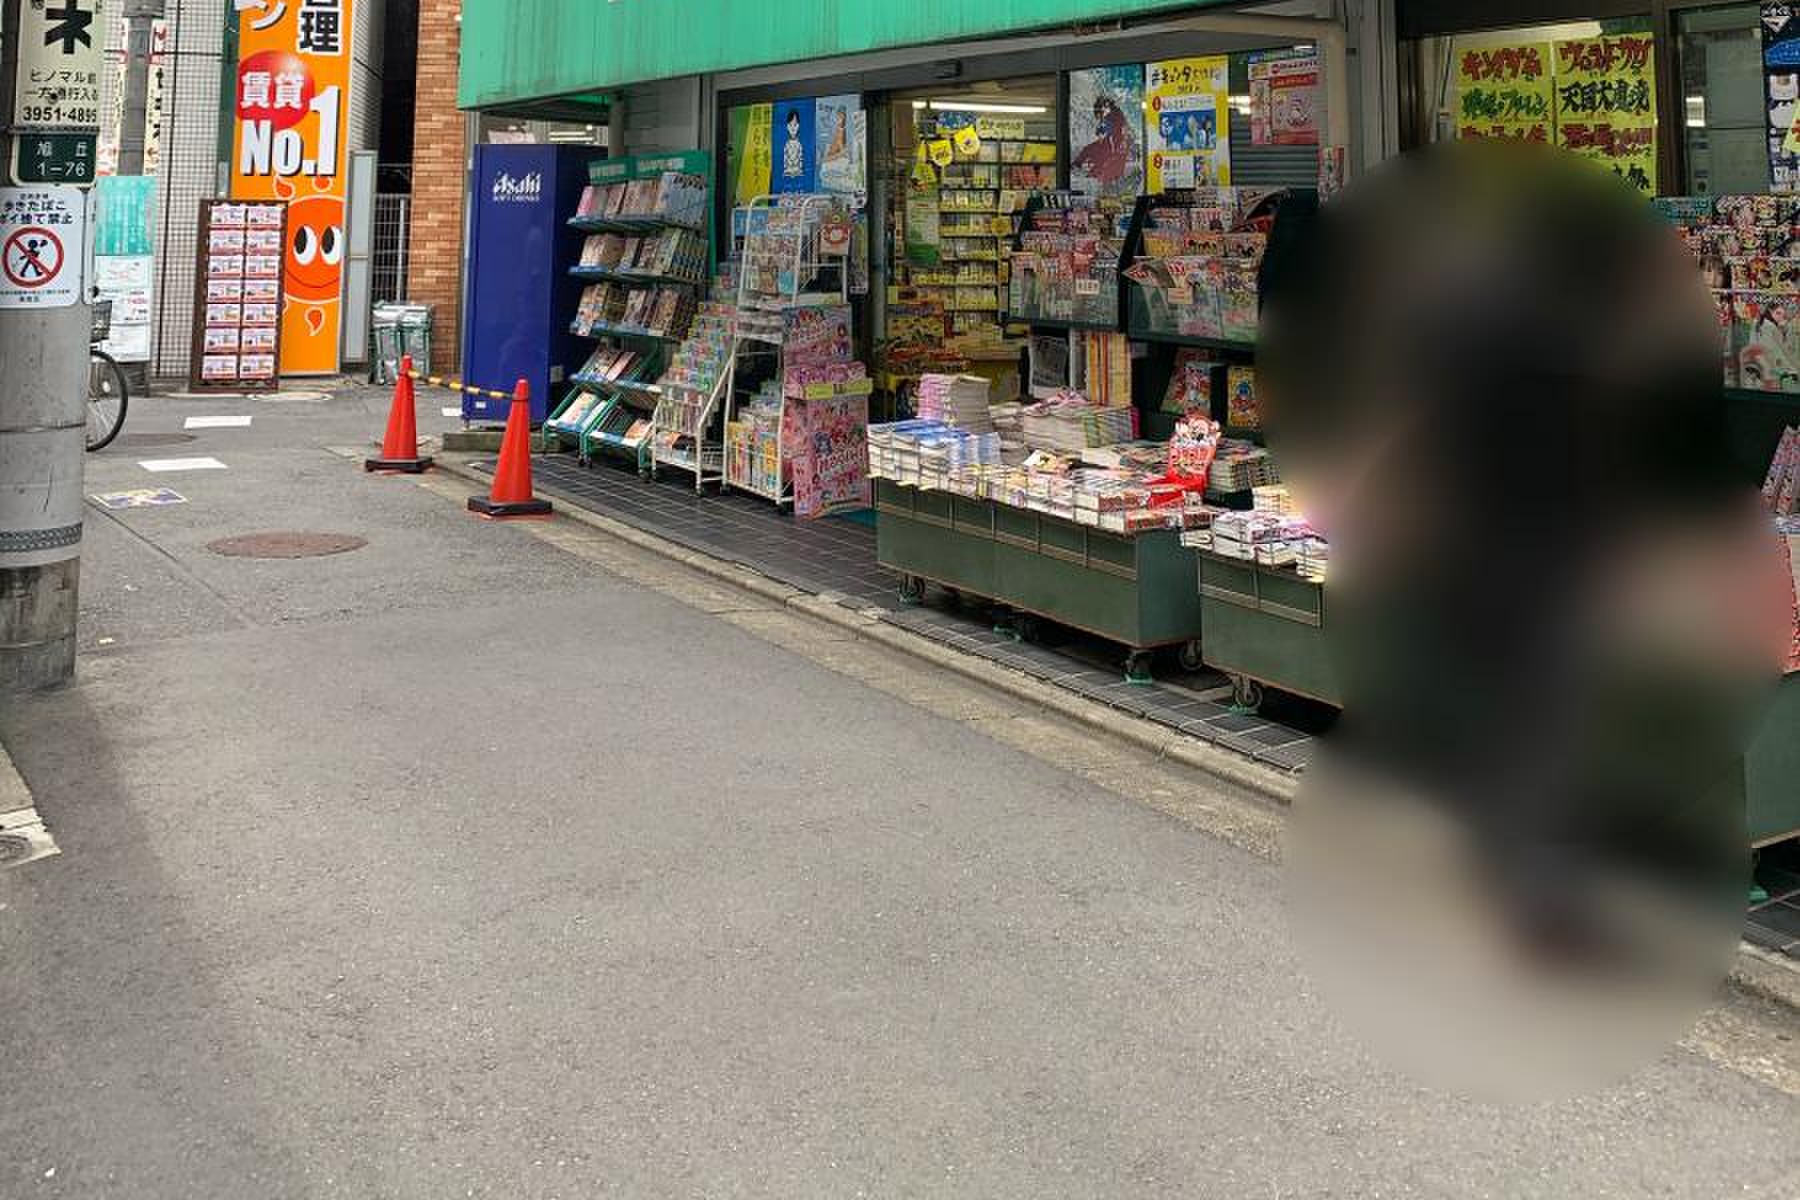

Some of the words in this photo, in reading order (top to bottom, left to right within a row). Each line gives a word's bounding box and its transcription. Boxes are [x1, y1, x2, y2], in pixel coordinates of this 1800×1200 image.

[241, 72, 305, 109] 賃貸
[240, 86, 340, 177] No.1
[493, 171, 542, 194] Asahi
